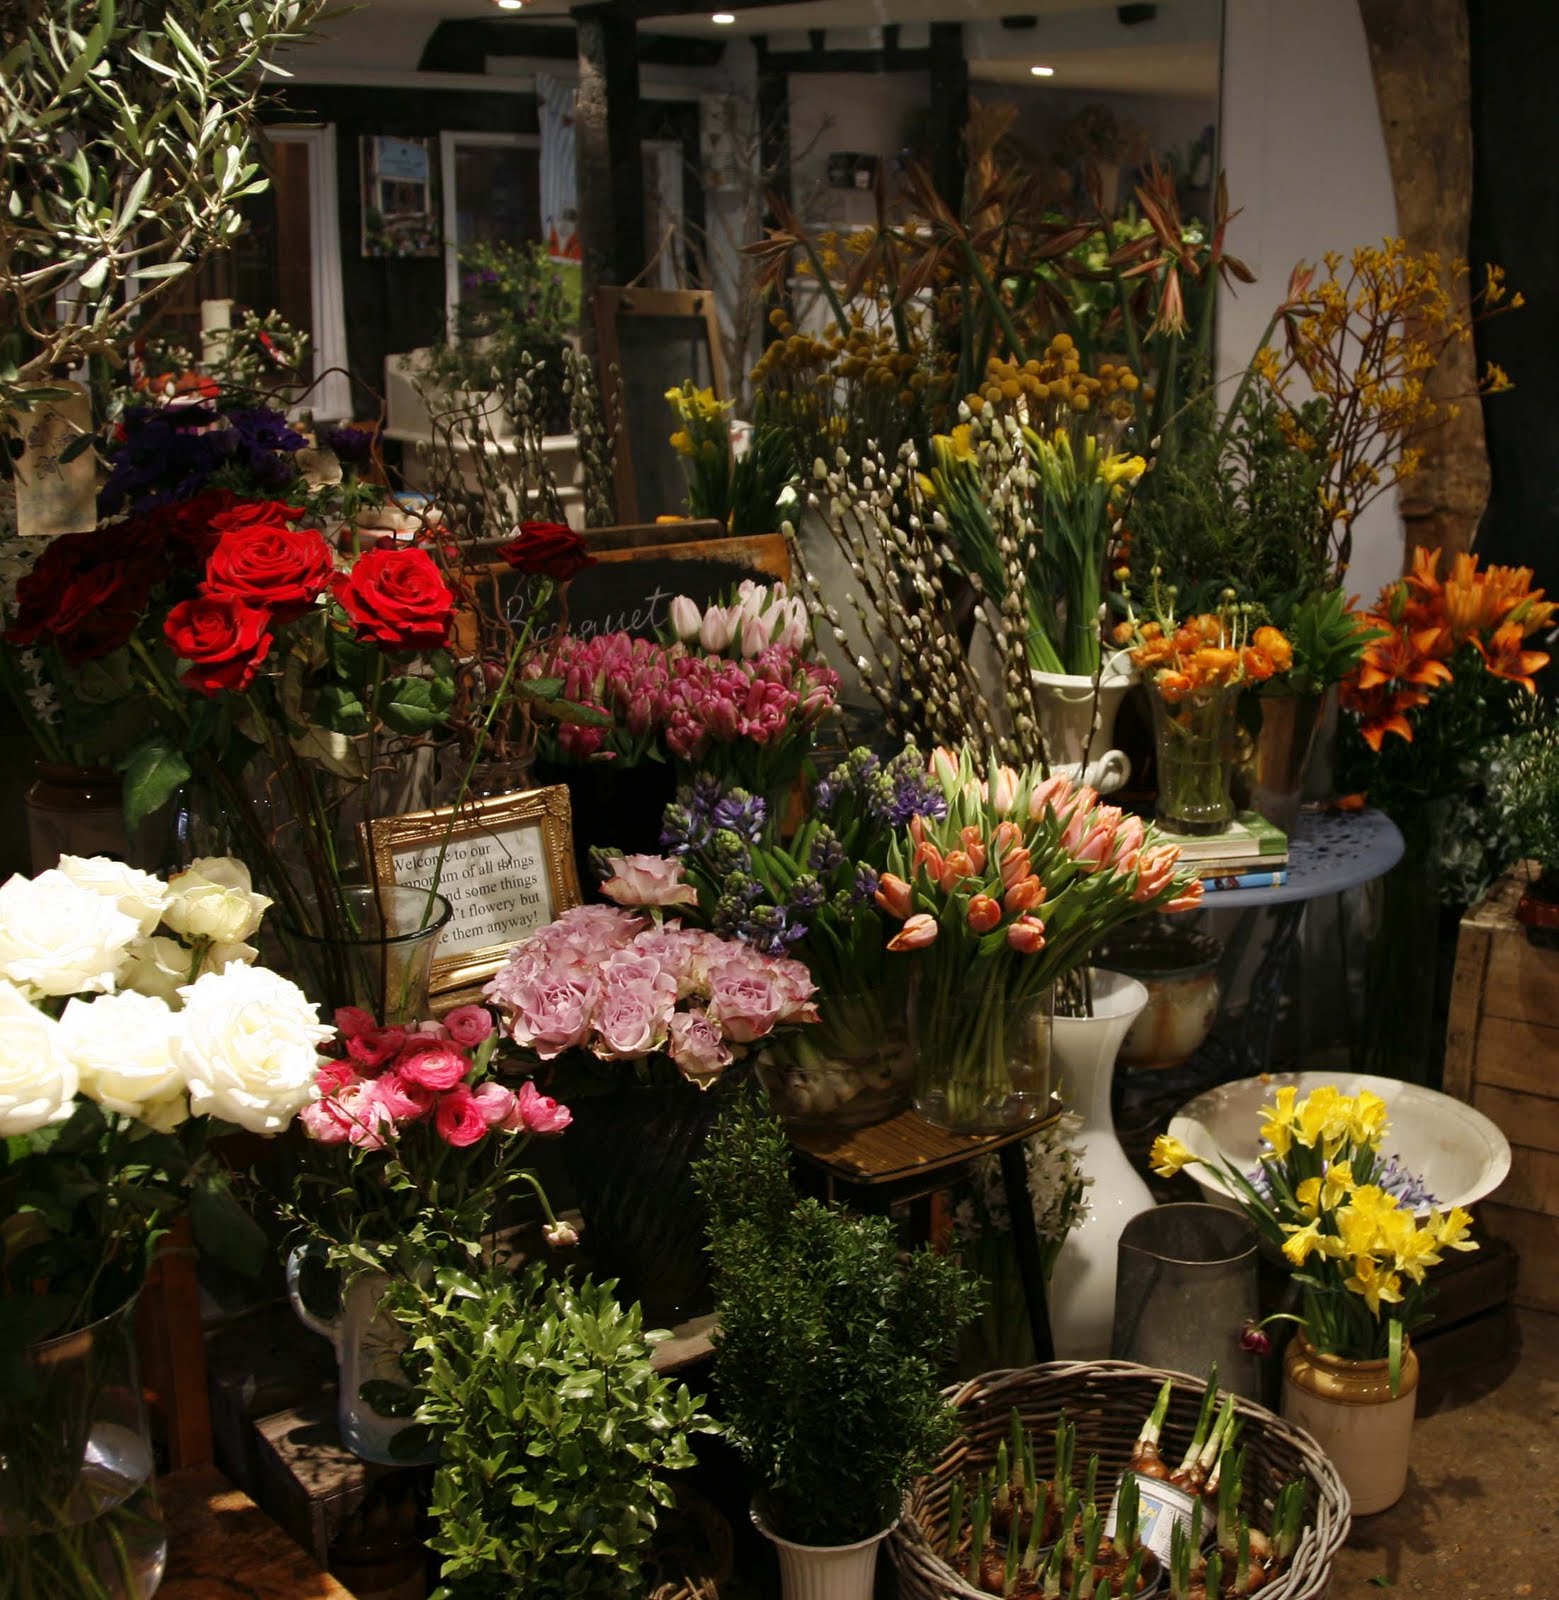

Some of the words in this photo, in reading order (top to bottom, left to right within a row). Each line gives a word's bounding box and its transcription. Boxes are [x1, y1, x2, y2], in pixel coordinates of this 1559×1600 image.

[455, 847, 467, 860] to
[470, 845, 491, 857] our
[400, 871, 458, 888] mporum
[462, 864, 476, 879] of
[478, 861, 493, 875] all
[497, 855, 534, 871] things
[445, 887, 461, 902] nd
[465, 883, 497, 899] some
[500, 874, 538, 890] things
[469, 898, 516, 917] flowery
[520, 892, 540, 906] but
[452, 926, 484, 941] them
[487, 910, 539, 933] anyway!
